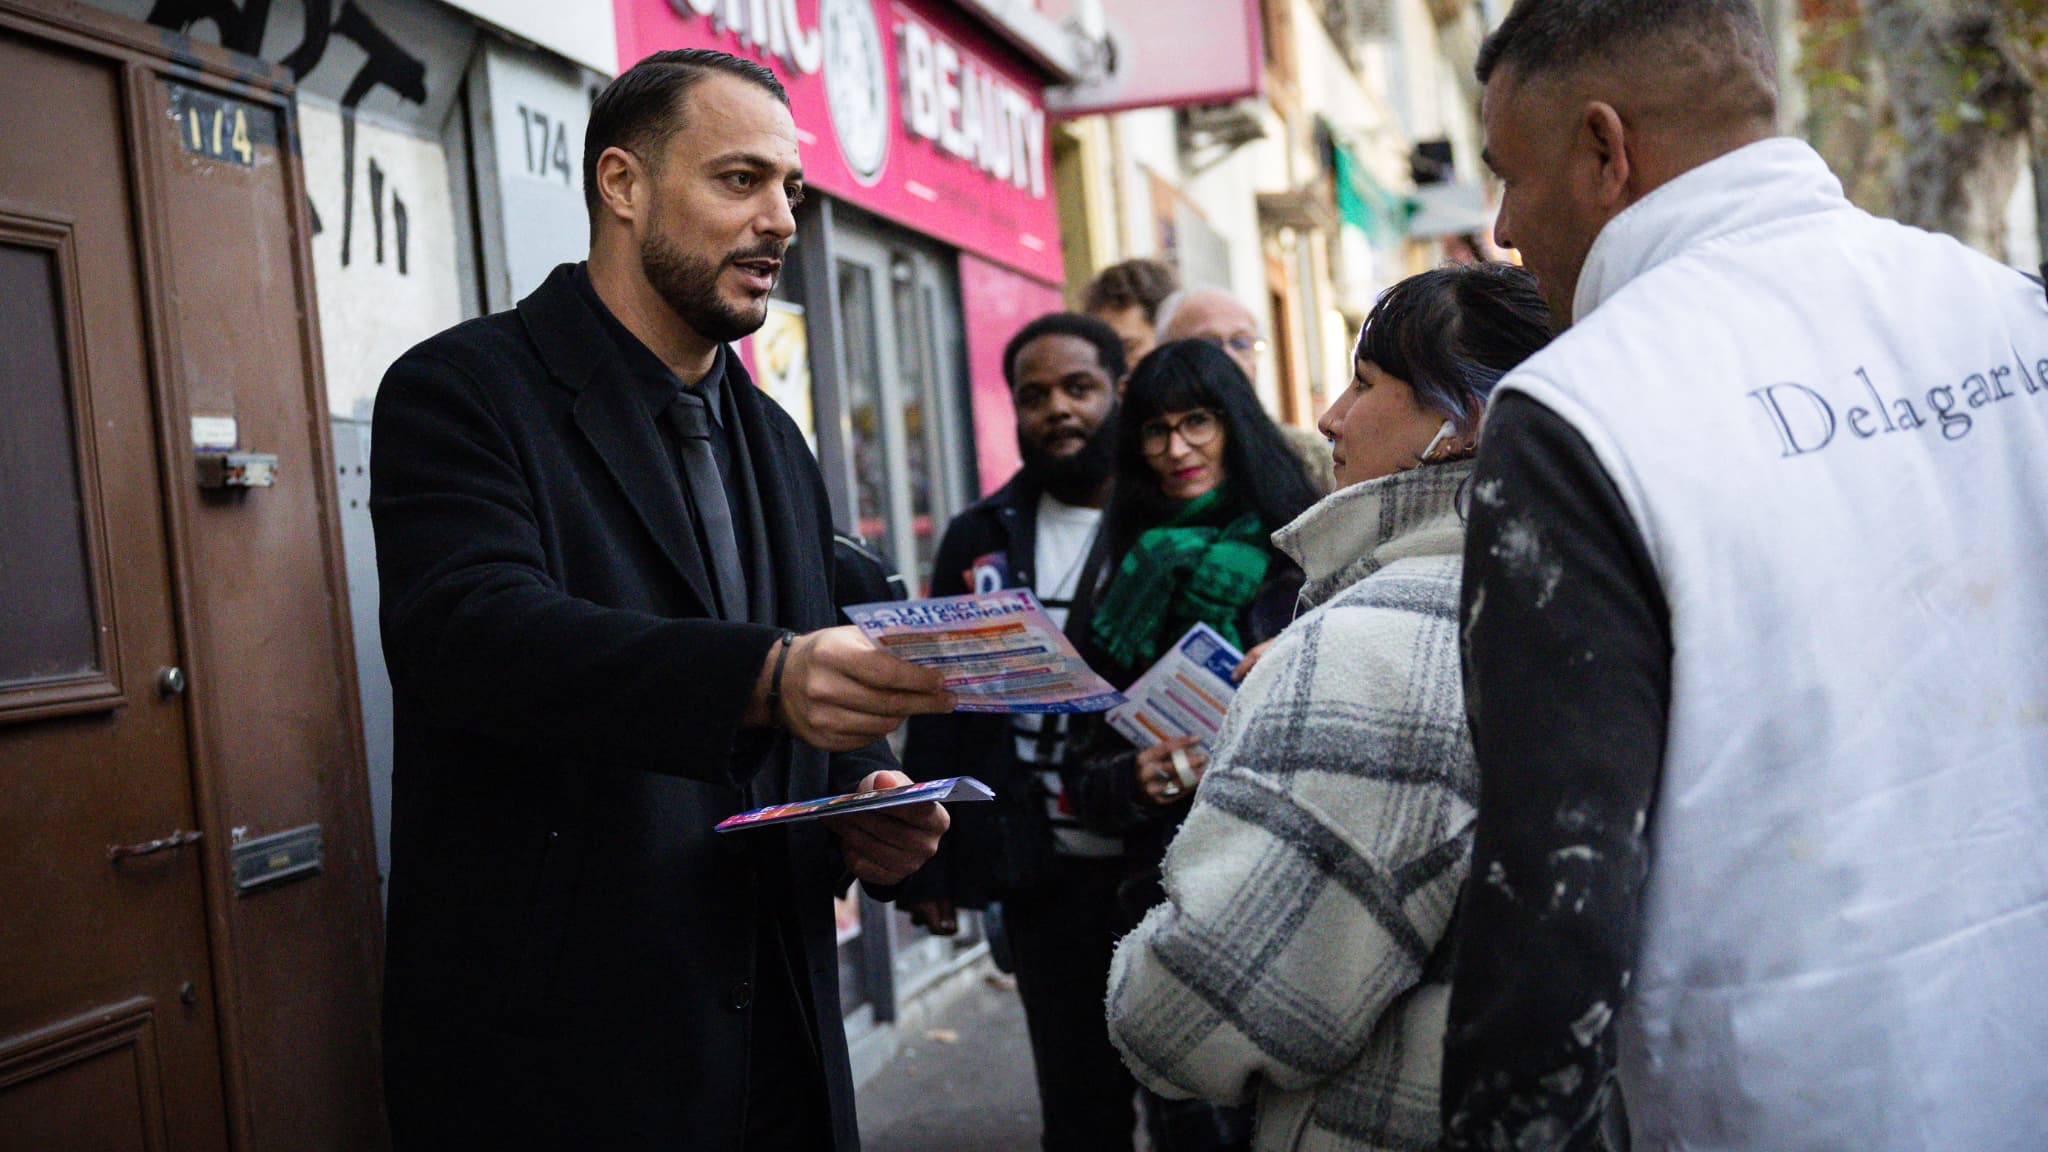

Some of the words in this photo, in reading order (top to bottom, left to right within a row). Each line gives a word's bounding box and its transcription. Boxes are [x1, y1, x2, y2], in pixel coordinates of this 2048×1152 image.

[903, 19, 1046, 199] BEAUTY
[517, 104, 571, 188] 174
[889, 614, 936, 627] TOUT
[920, 601, 978, 615] FORCE
